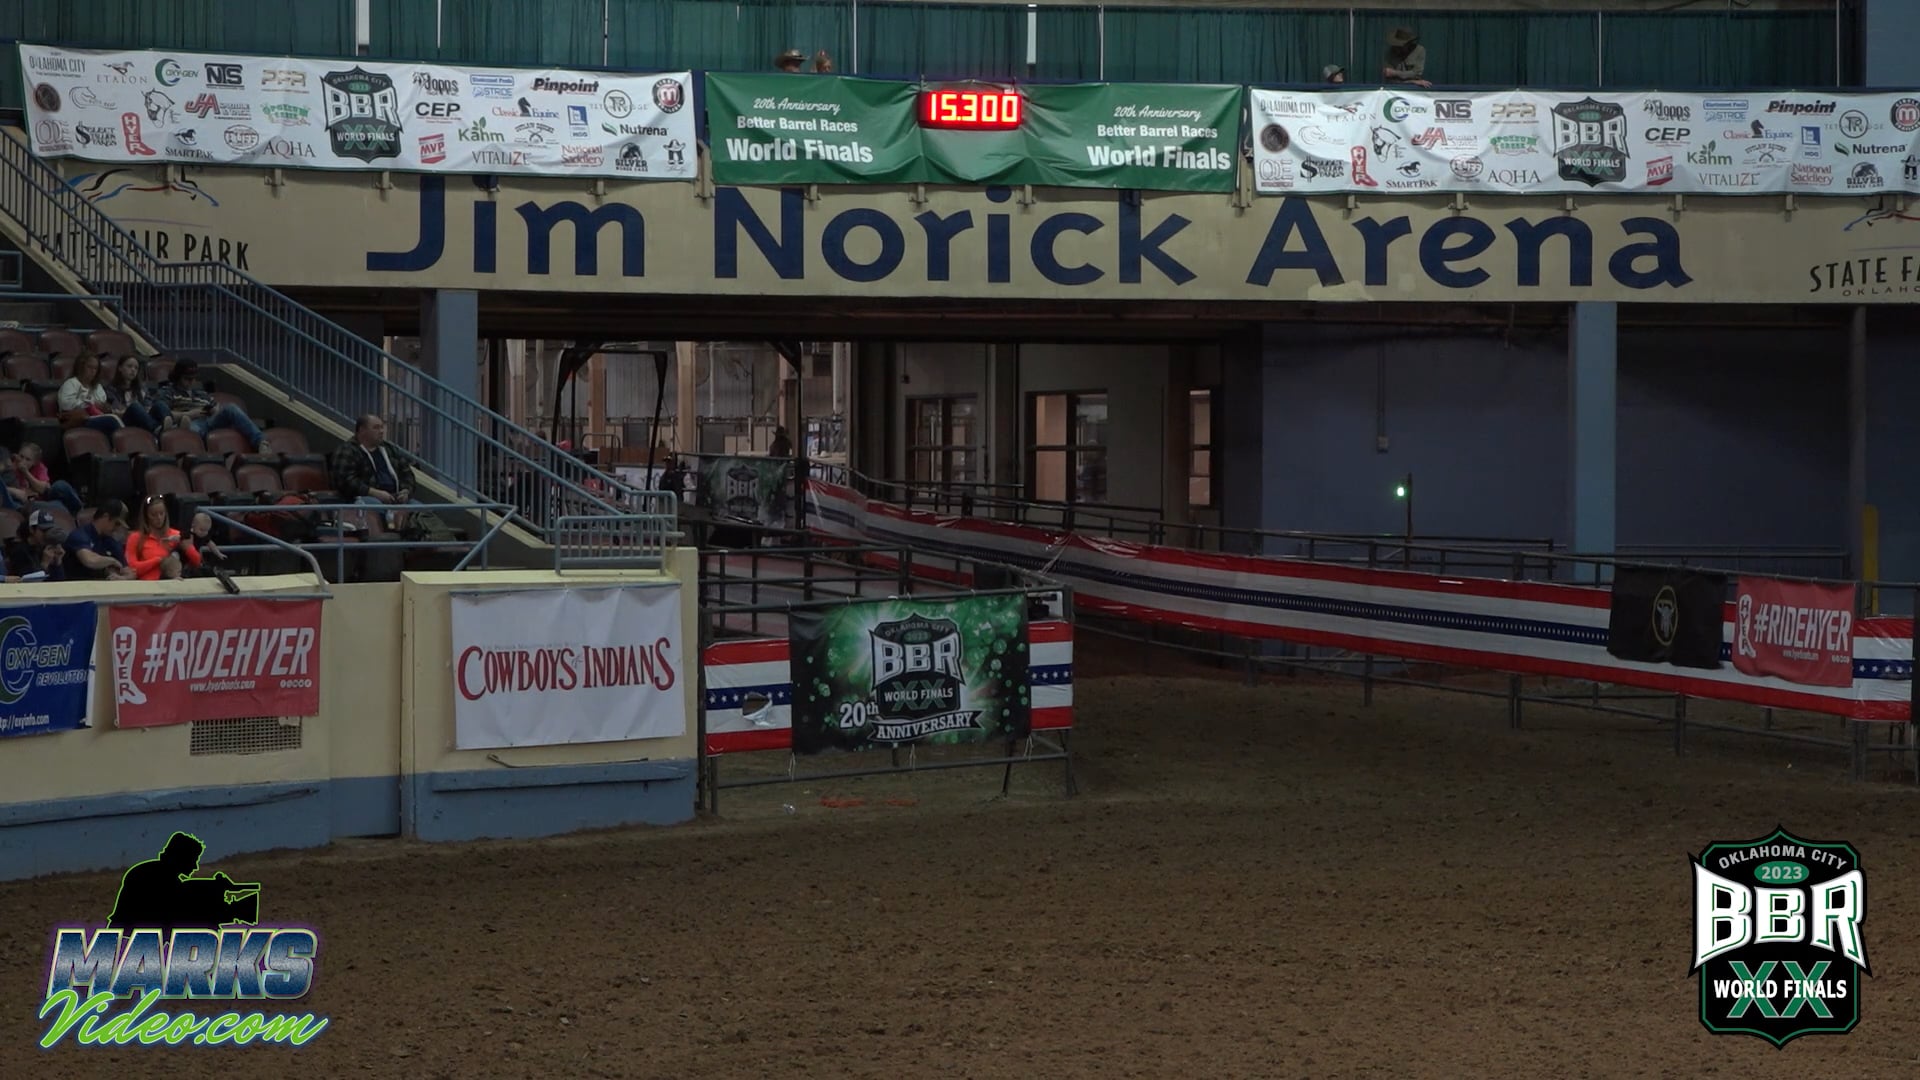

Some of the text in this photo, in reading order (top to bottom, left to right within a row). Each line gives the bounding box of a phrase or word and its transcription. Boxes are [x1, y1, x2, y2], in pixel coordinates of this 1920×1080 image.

[534, 78, 599, 95] Pinpoint
[322, 80, 401, 129] BBR
[415, 102, 460, 117] CEP
[753, 97, 840, 115] 20th Anniversary
[929, 94, 1018, 123] 15.300
[1113, 104, 1202, 121] 20th Anniversary
[1767, 100, 1836, 115] Pinpoint
[619, 124, 667, 136] Nutrena
[737, 115, 858, 132] Better Barrel Races
[1097, 124, 1218, 139] Better Barrel Races
[124, 116, 147, 151] HYER
[337, 132, 394, 141] WORLD FINALS
[1552, 112, 1627, 154] BBR
[1644, 128, 1691, 141] CEP
[1723, 130, 1793, 140] Classic Equine
[262, 139, 316, 159] AQHA
[420, 142, 445, 155] MVP
[561, 145, 602, 155] National
[726, 138, 873, 163] World Finals
[1852, 144, 1906, 154] Nutrena
[471, 151, 530, 166] VITALIZE
[560, 154, 604, 167] Saddlery
[615, 159, 648, 167] SILVER
[1087, 145, 1231, 170] World Finals
[1352, 149, 1366, 181] HYER
[1563, 158, 1620, 168] WORLD FINALS
[1646, 163, 1673, 178] MVP
[1791, 163, 1832, 174] National
[1488, 170, 1542, 187] AQHA
[1698, 173, 1760, 186] VITALIZE
[1790, 173, 1833, 185] Saddlery
[1846, 177, 1883, 185] SILVER
[366, 187, 1694, 289] Jim Norick Arena
[184, 233, 249, 272] PARK
[1810, 257, 1888, 293] STATE
[1741, 600, 1751, 650] HYER
[1754, 603, 1852, 652] #RIDEHYER
[5, 644, 71, 671] OXY-GEN
[142, 627, 315, 683] #RIDEHYER
[872, 632, 962, 687] BBR
[115, 633, 136, 696] HYER
[457, 645, 577, 701] COWBOYS
[582, 636, 675, 691] INDIANS
[884, 687, 953, 702] WORLD FINALS
[839, 700, 880, 730] 20th
[876, 711, 973, 740] ANNIVERSARY
